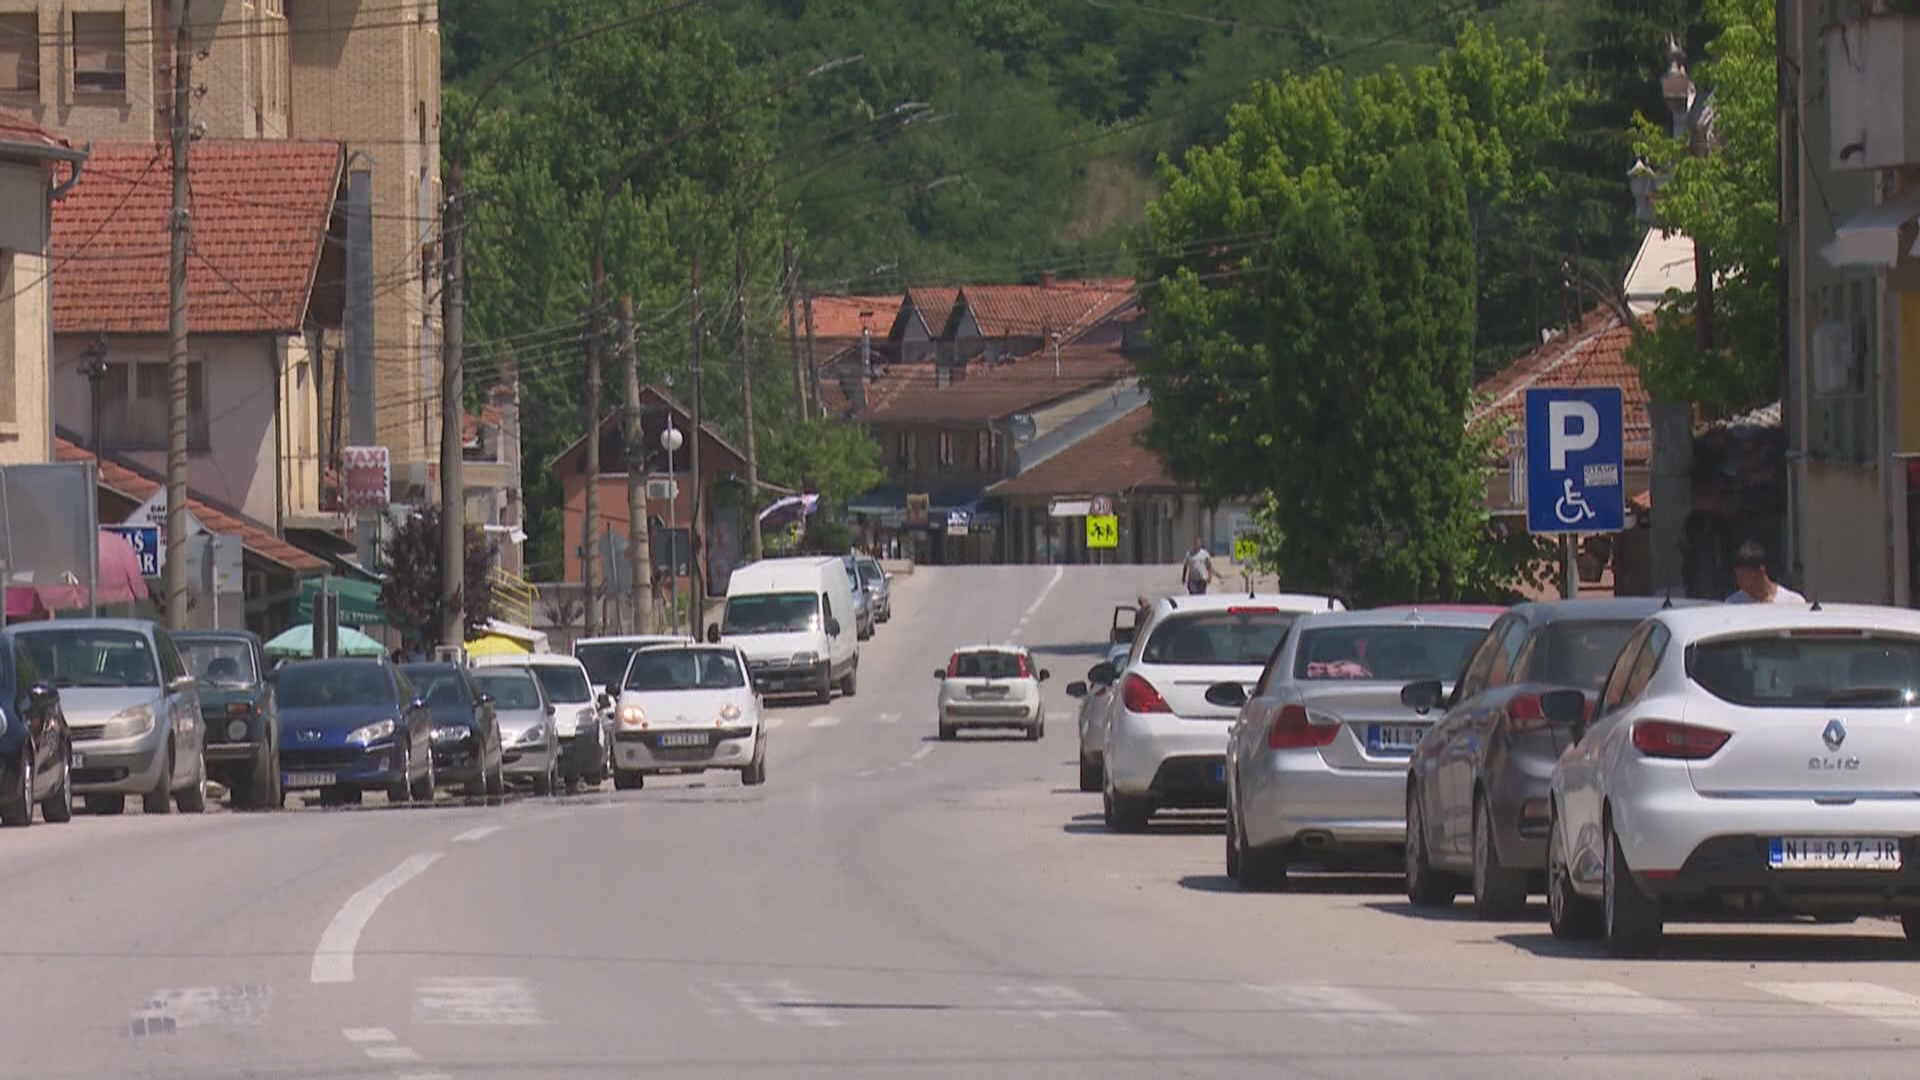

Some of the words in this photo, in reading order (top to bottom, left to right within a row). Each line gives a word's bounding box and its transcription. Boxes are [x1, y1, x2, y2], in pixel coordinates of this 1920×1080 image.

[1549, 401, 1600, 471] P
[346, 451, 386, 463] TAXI
[1382, 728, 1400, 745] NI
[1808, 757, 1860, 770] CLIO
[1786, 840, 1808, 861] NI
[1826, 841, 1896, 861] 097-JR
